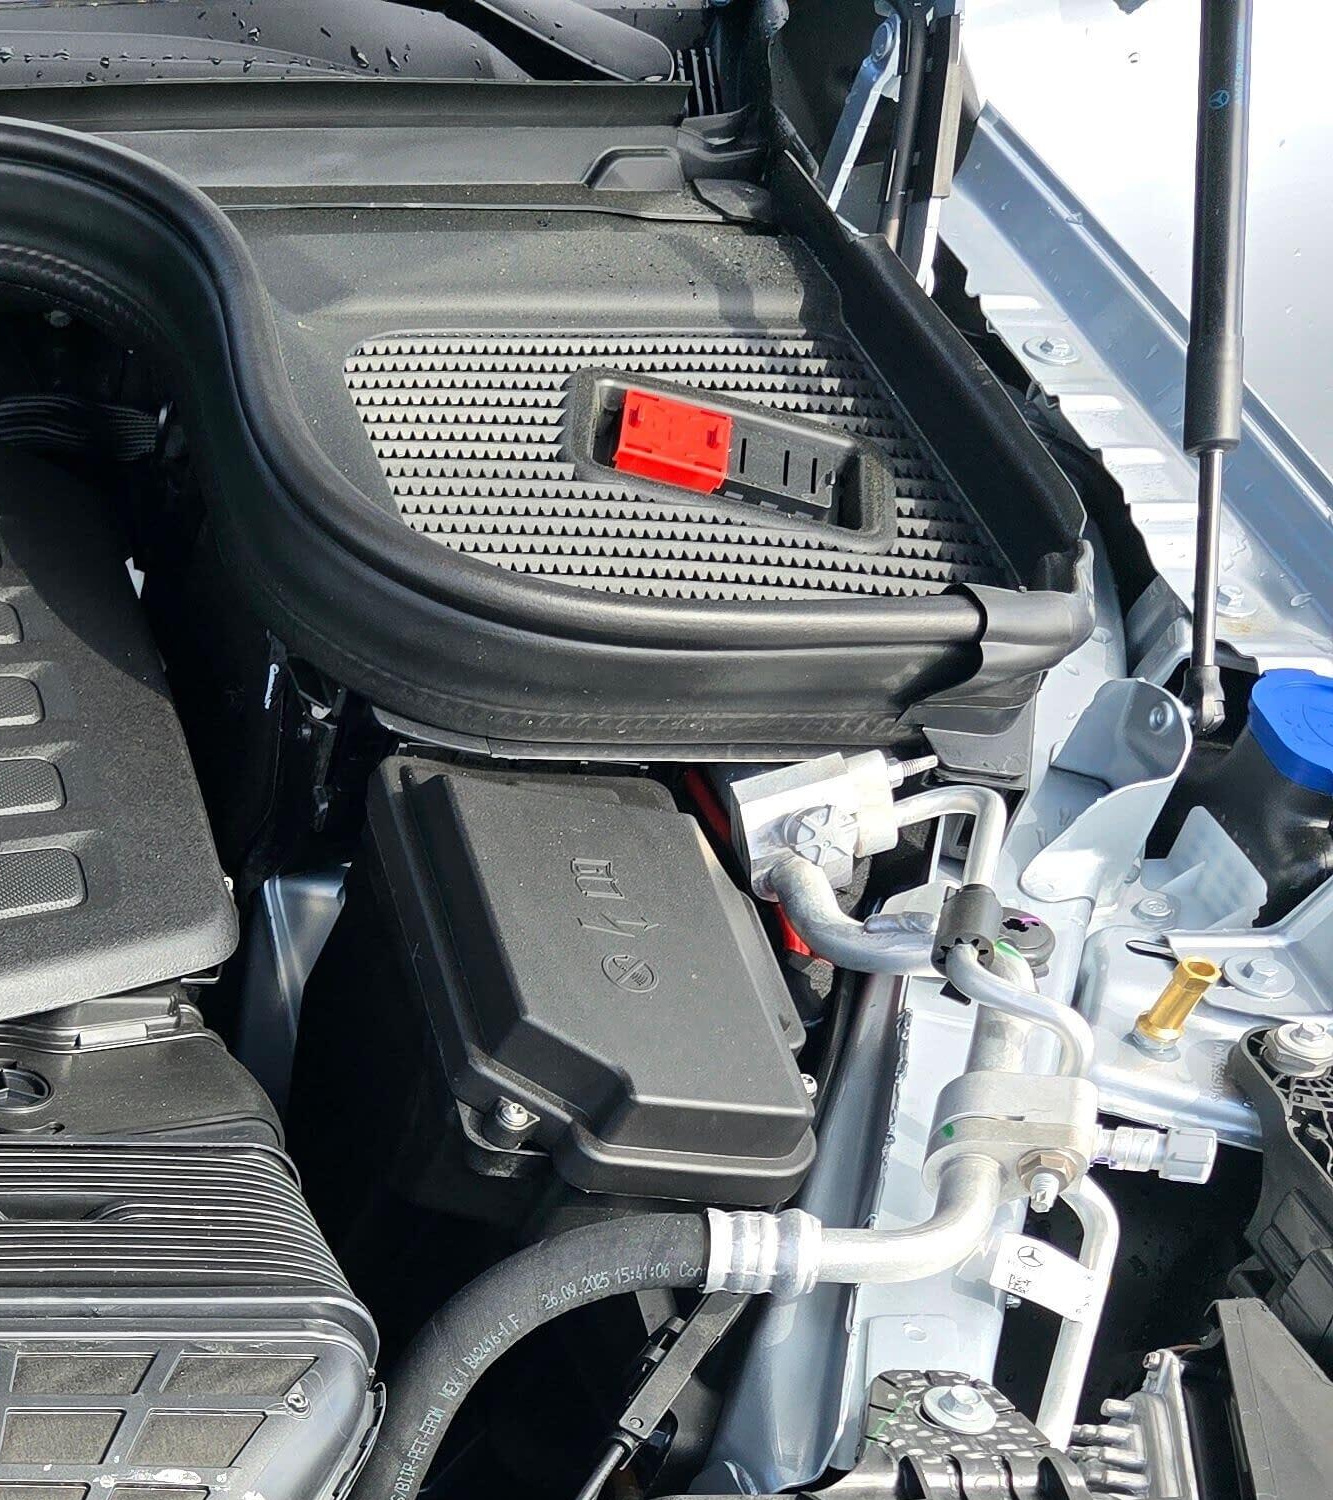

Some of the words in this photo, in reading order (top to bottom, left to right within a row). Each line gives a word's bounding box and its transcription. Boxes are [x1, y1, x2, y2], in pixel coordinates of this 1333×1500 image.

[541, 1271, 611, 1311] 26.09.2025
[614, 1262, 671, 1285] 15:41:06
[679, 1261, 707, 1278] Con
